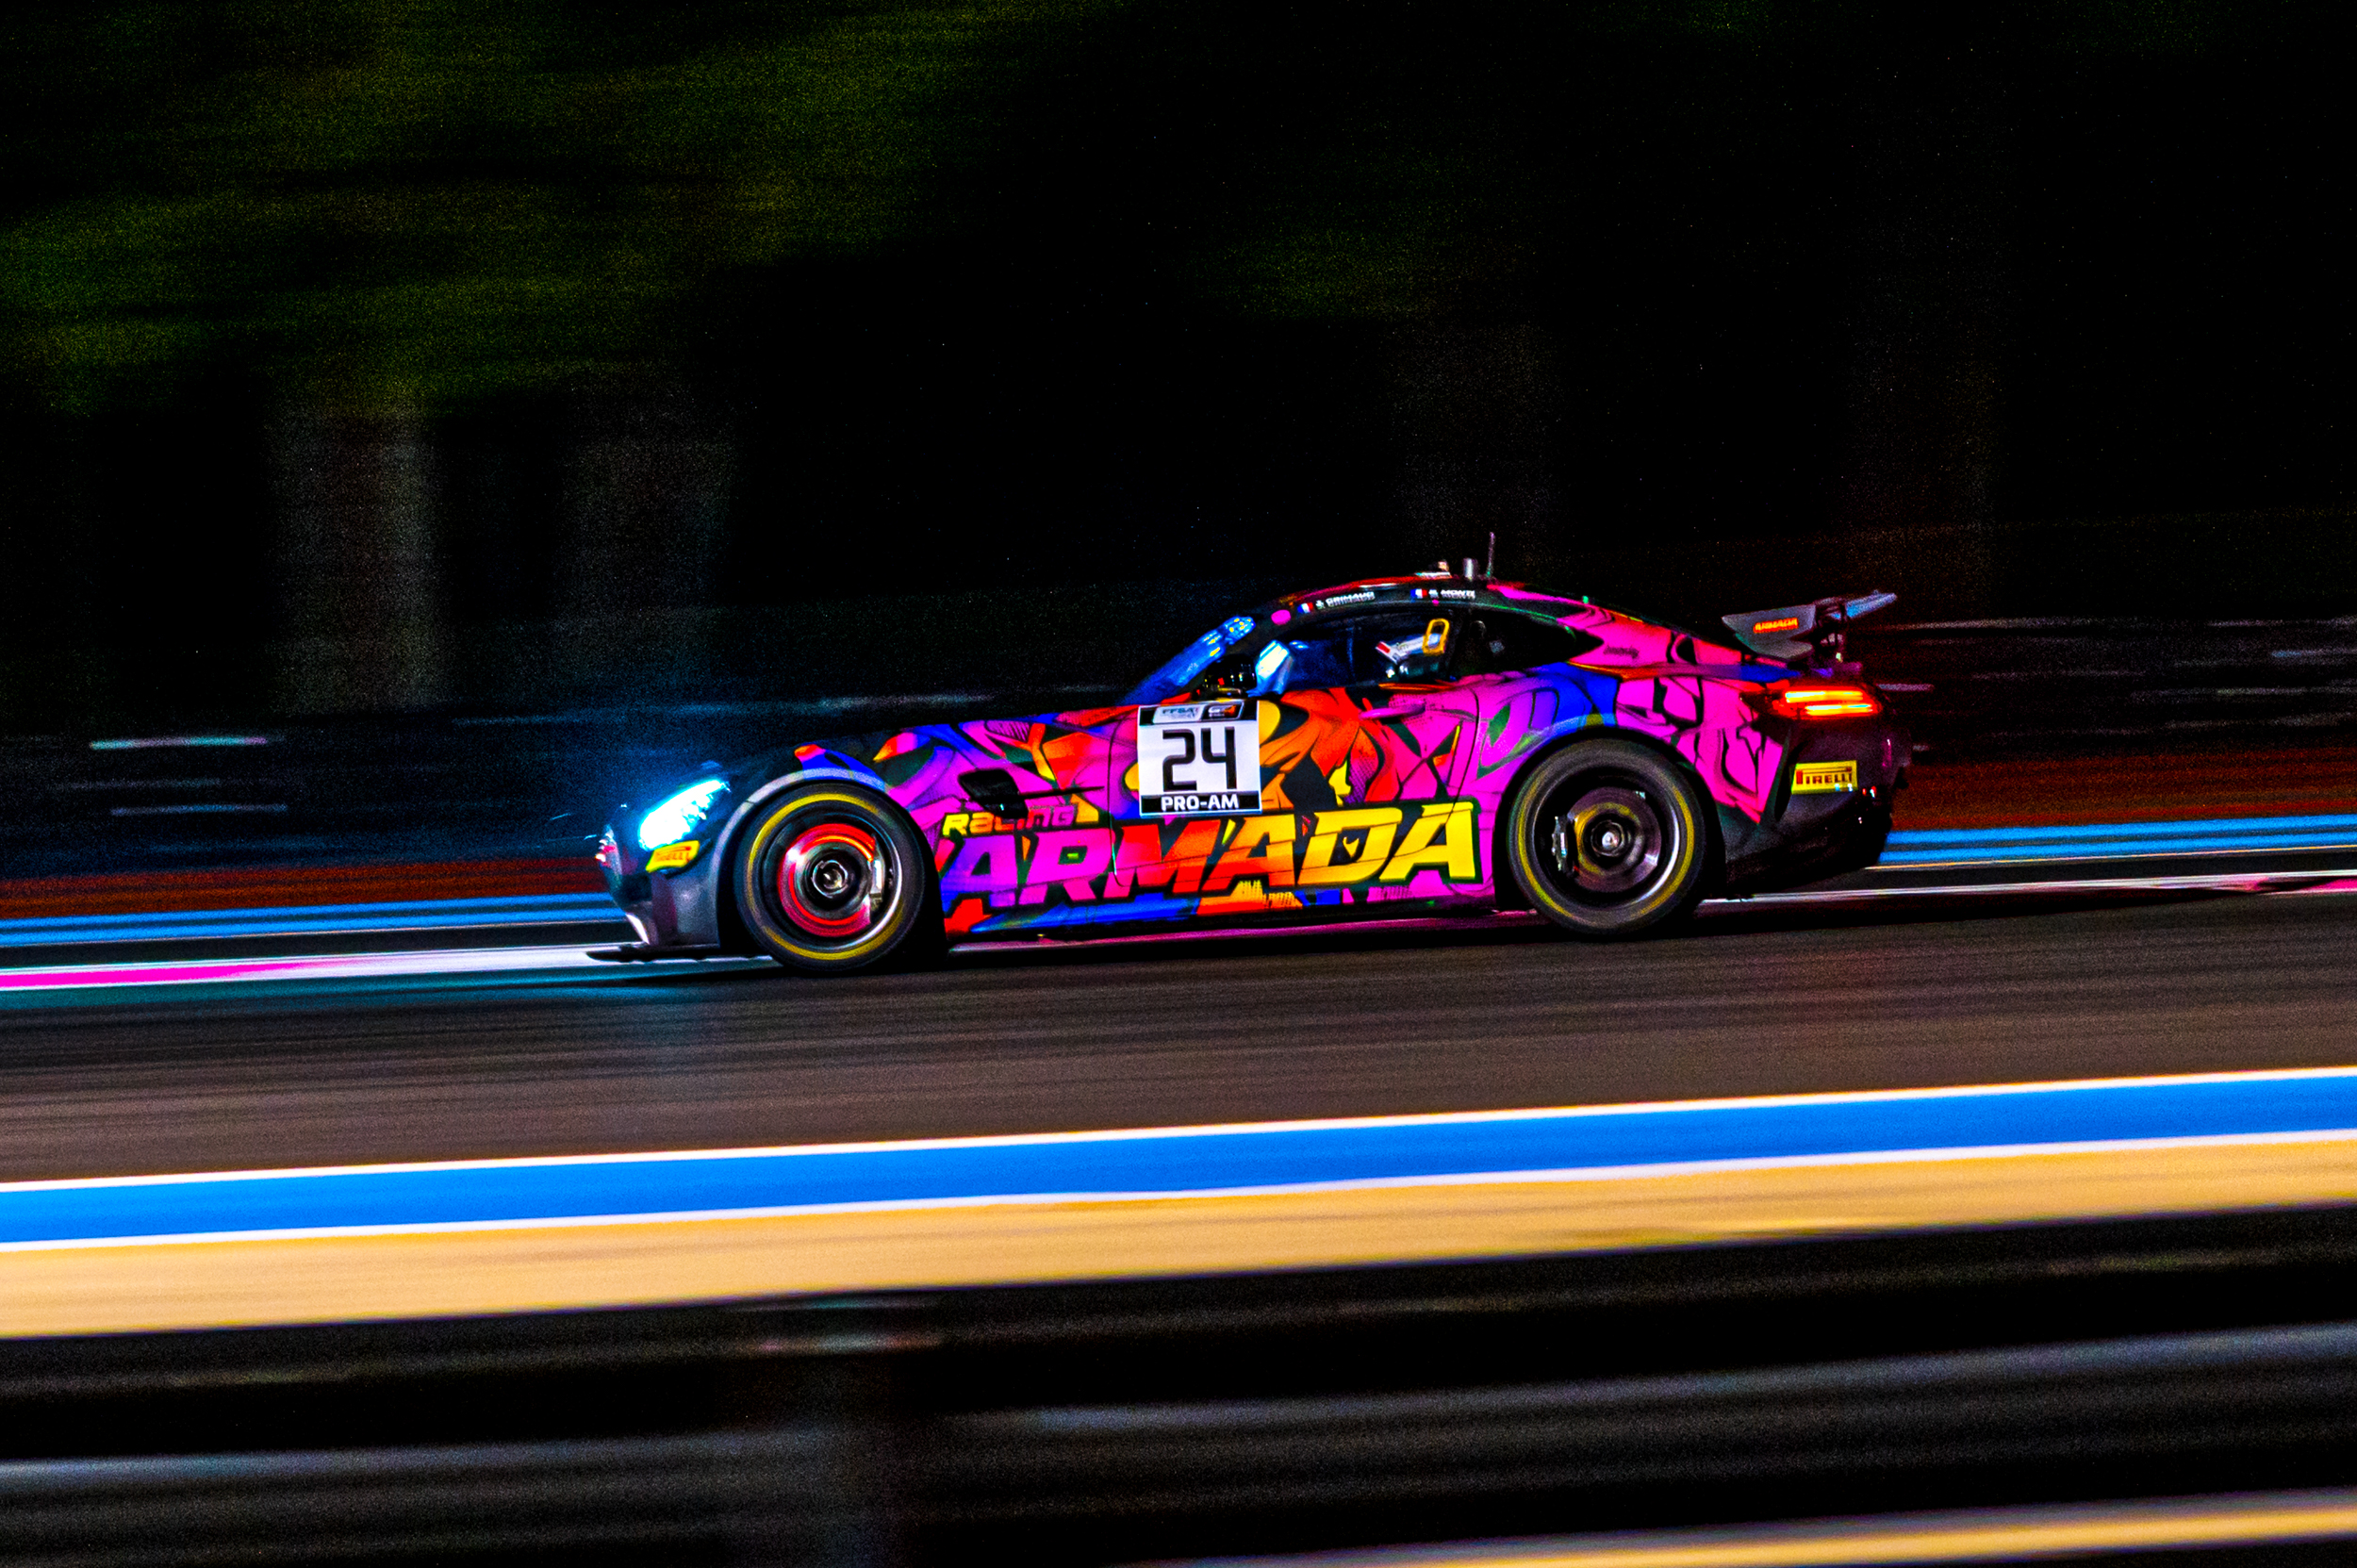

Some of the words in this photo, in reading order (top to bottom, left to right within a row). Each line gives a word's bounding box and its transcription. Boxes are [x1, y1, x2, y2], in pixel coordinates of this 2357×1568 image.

[1162, 726, 1238, 792] 24
[1795, 767, 1853, 785] PIRELLI
[1161, 793, 1240, 812] PRO-AM
[940, 801, 1475, 907] ARMADA
